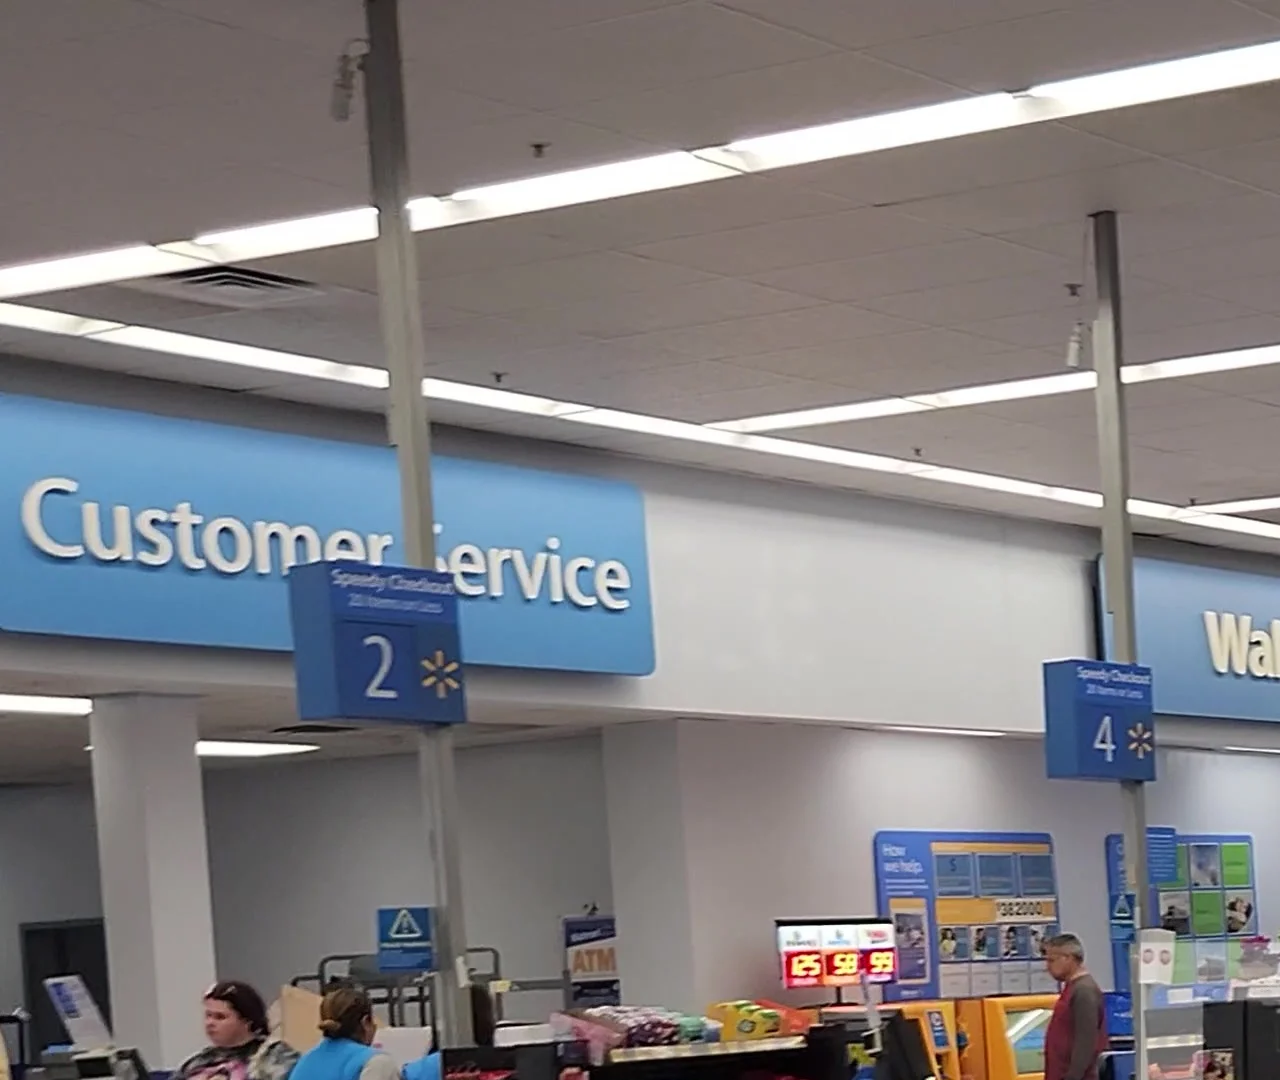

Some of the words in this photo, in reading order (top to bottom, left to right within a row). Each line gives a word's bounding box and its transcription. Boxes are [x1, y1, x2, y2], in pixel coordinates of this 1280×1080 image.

[22, 478, 393, 577] Customer
[433, 524, 631, 610] ervice
[331, 569, 386, 592] Speedy
[388, 574, 456, 596] Checkout
[363, 635, 398, 699] 2
[1077, 666, 1109, 683] Speedy
[1110, 669, 1151, 685] Checkout
[1093, 716, 1117, 762] 4
[572, 947, 617, 974] ATM
